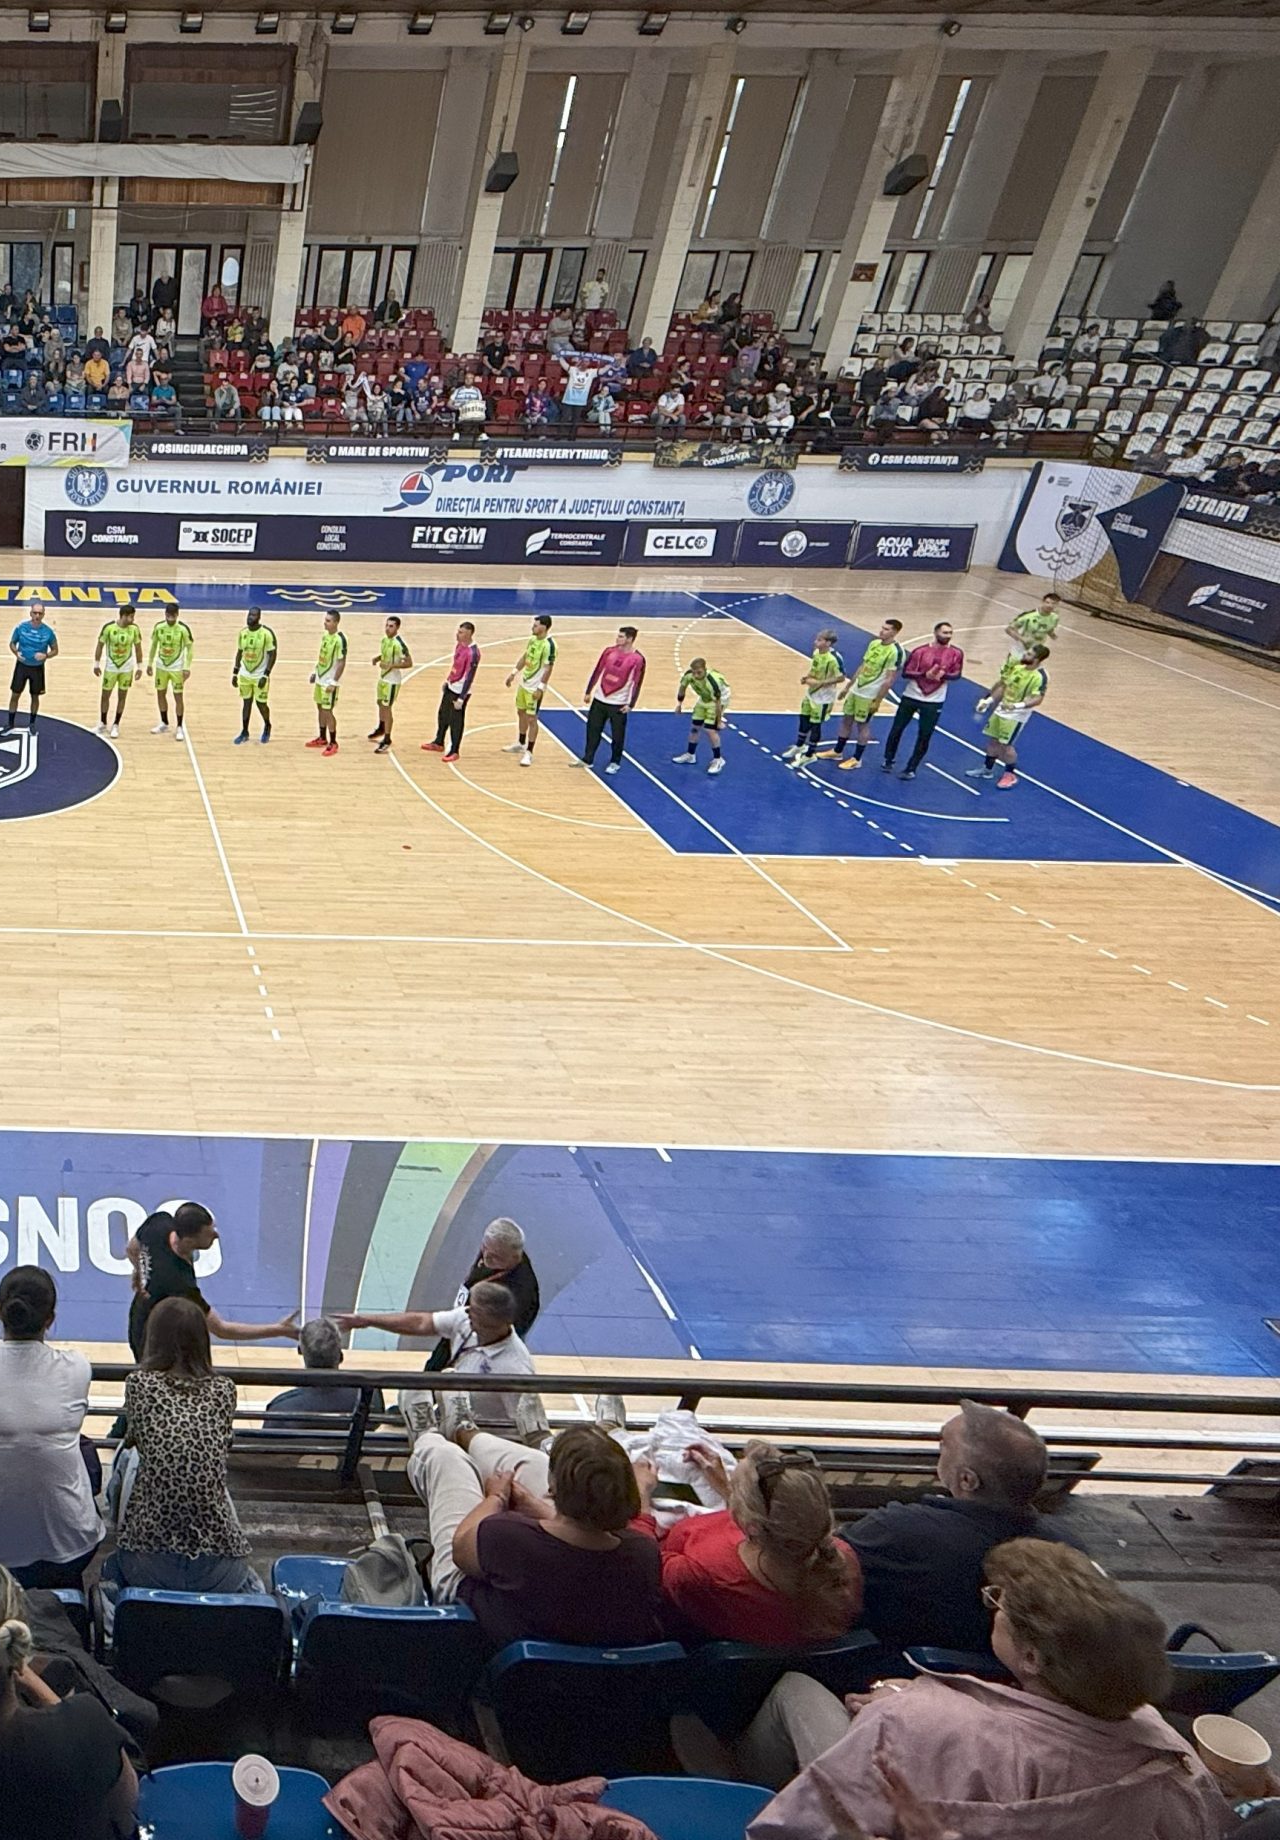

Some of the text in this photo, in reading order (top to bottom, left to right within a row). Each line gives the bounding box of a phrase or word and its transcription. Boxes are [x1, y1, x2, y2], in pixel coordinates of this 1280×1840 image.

[48, 432, 97, 452] FRH
[151, 443, 248, 455] #OSINGURAECHIPA
[329, 447, 429, 457] O MARE DE SPORTIVI
[495, 447, 609, 460] #TEAMISEVERYTHING
[881, 455, 902, 465] CSM
[116, 478, 322, 495] GUVERNUL ROMÂNIEI
[483, 498, 522, 514] PENTRU
[525, 498, 558, 514] SPORT
[559, 499, 566, 514] A
[106, 525, 125, 535] CSM
[211, 528, 253, 543] SOCEP
[877, 537, 913, 547] AQUA
[877, 547, 909, 557] FLUX
